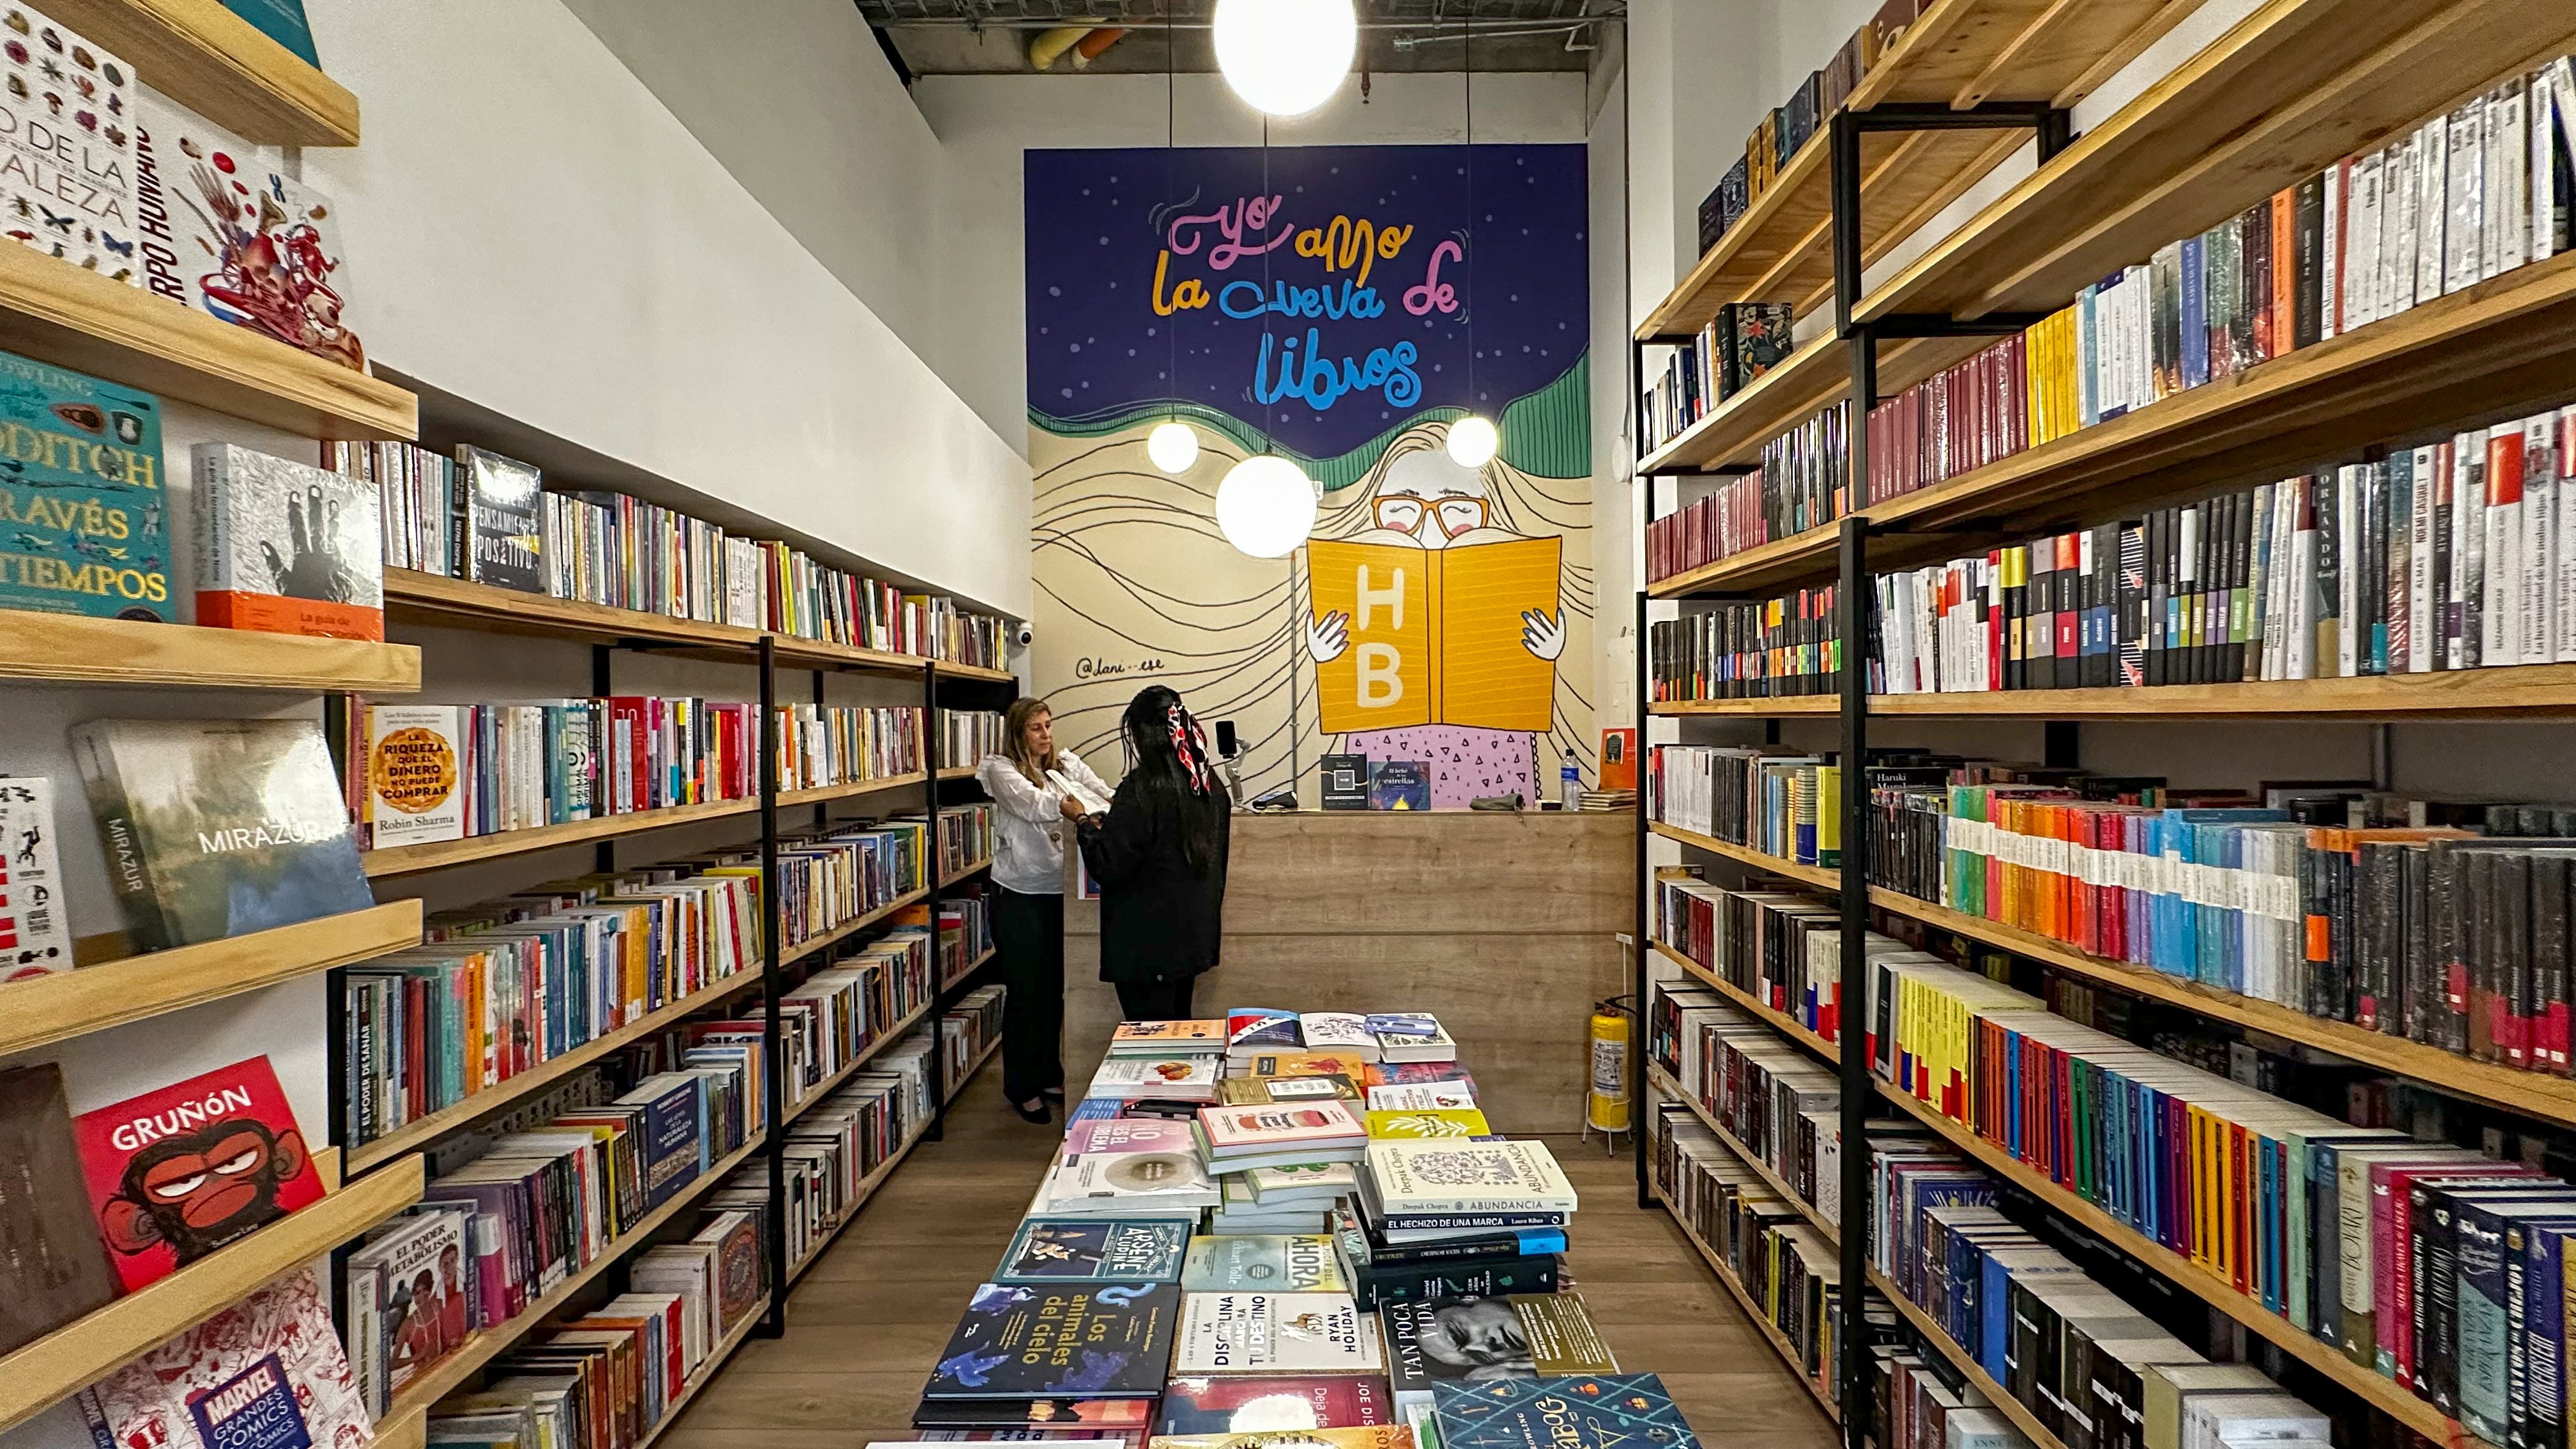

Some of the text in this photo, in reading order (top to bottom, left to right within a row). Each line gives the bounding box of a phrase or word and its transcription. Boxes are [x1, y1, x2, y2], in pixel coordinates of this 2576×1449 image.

[29, 120, 75, 164] DE
[84, 146, 127, 189] LA
[0, 154, 128, 228] ALEZA
[1295, 214, 1414, 288] amo
[140, 241, 187, 307] RPO
[1153, 250, 1210, 316] la
[1402, 240, 1464, 316] de
[2322, 268, 2334, 330] Rosa Montero
[3, 360, 93, 397] OWLING
[1254, 328, 1422, 411] libros
[0, 489, 129, 540] RAVÉS
[2414, 477, 2428, 514] CASQUET
[2413, 516, 2428, 543] NOEMÍ
[2414, 556, 2425, 589] ALMAS
[1356, 564, 1404, 631] H
[1356, 642, 1404, 709] B
[384, 744, 445, 754] RIQUEZA
[397, 755, 433, 764] QUE EL
[389, 765, 441, 777] DINERO
[391, 776, 440, 786] NO PUEDE
[1877, 773, 1906, 783] Haruki
[382, 786, 448, 799] COMPRAR
[197, 819, 330, 854] MIRAZUR
[379, 814, 455, 831] Robin Sharma
[107, 817, 144, 893] MIRAZUR
[362, 1024, 371, 1059] SANAR
[361, 1076, 371, 1111] PODER
[111, 1084, 253, 1151] GRUÑÓN
[360, 1112, 371, 1127] EL
[1088, 1124, 1114, 1153] OBLEMA
[1390, 1148, 1414, 1194] Deepak Chopra
[1505, 1143, 1546, 1194] ABUNDANCIA
[1388, 1220, 1399, 1229] EL
[1400, 1219, 1438, 1229] HECHIZO
[1439, 1218, 1451, 1227] DE
[1452, 1218, 1471, 1227] UNA
[1472, 1217, 1504, 1227] MARCA
[1426, 1202, 1448, 1211] Chopra
[1470, 1200, 1543, 1210] ABUNDANCIA
[395, 1224, 447, 1261] EL PODER
[1112, 1236, 1131, 1262] LUPIN
[1228, 1266, 1242, 1285] Tolle
[1291, 1236, 1321, 1289] AHORA
[1324, 1269, 1333, 1282] DEL
[2413, 1233, 2425, 1330] ARTHUR GORDON PYM
[1021, 1296, 1068, 1365] del cielo
[1050, 1294, 1089, 1365] animales
[1086, 1314, 1117, 1342] Los
[1203, 1322, 1213, 1333] LA
[1214, 1296, 1234, 1366] DISCIPLINA
[1249, 1296, 1266, 1365] TU DESTINO
[1327, 1314, 1340, 1342] RYAN
[1340, 1305, 1356, 1352] HOLIDAY
[1416, 1300, 1438, 1338] VIDA
[1396, 1301, 1425, 1380] TAN POCA
[204, 1364, 279, 1425] MARVEL
[2527, 1330, 2559, 1425] FRANKENSTEIN
[214, 1388, 284, 1440] GRANDES
[1313, 1388, 1330, 1427] Deja de
[1358, 1382, 1374, 1427] JOE DIS
